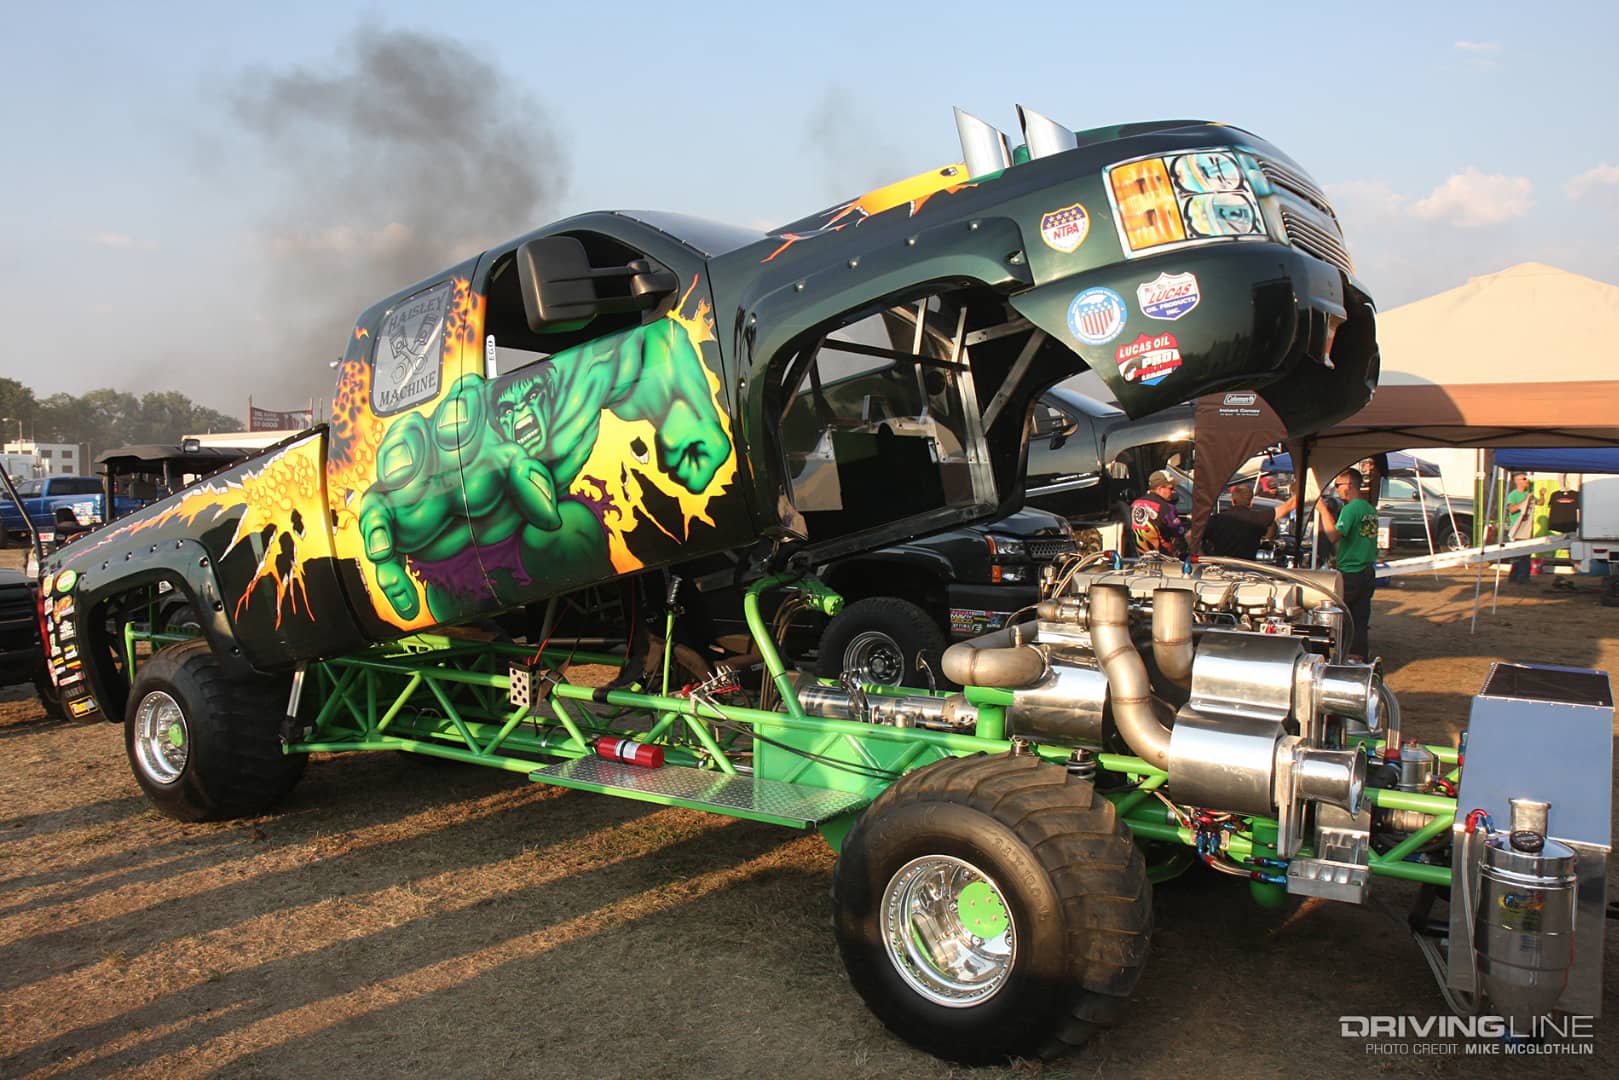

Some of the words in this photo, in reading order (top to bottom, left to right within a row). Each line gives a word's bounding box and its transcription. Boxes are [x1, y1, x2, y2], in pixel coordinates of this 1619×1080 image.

[1053, 222, 1080, 241] NTPA
[1149, 283, 1192, 305] LUCAS
[1146, 305, 1159, 314] OIL
[1119, 340, 1152, 359] LUCAS
[1153, 336, 1170, 349] OIL
[379, 371, 436, 406] MACHINE
